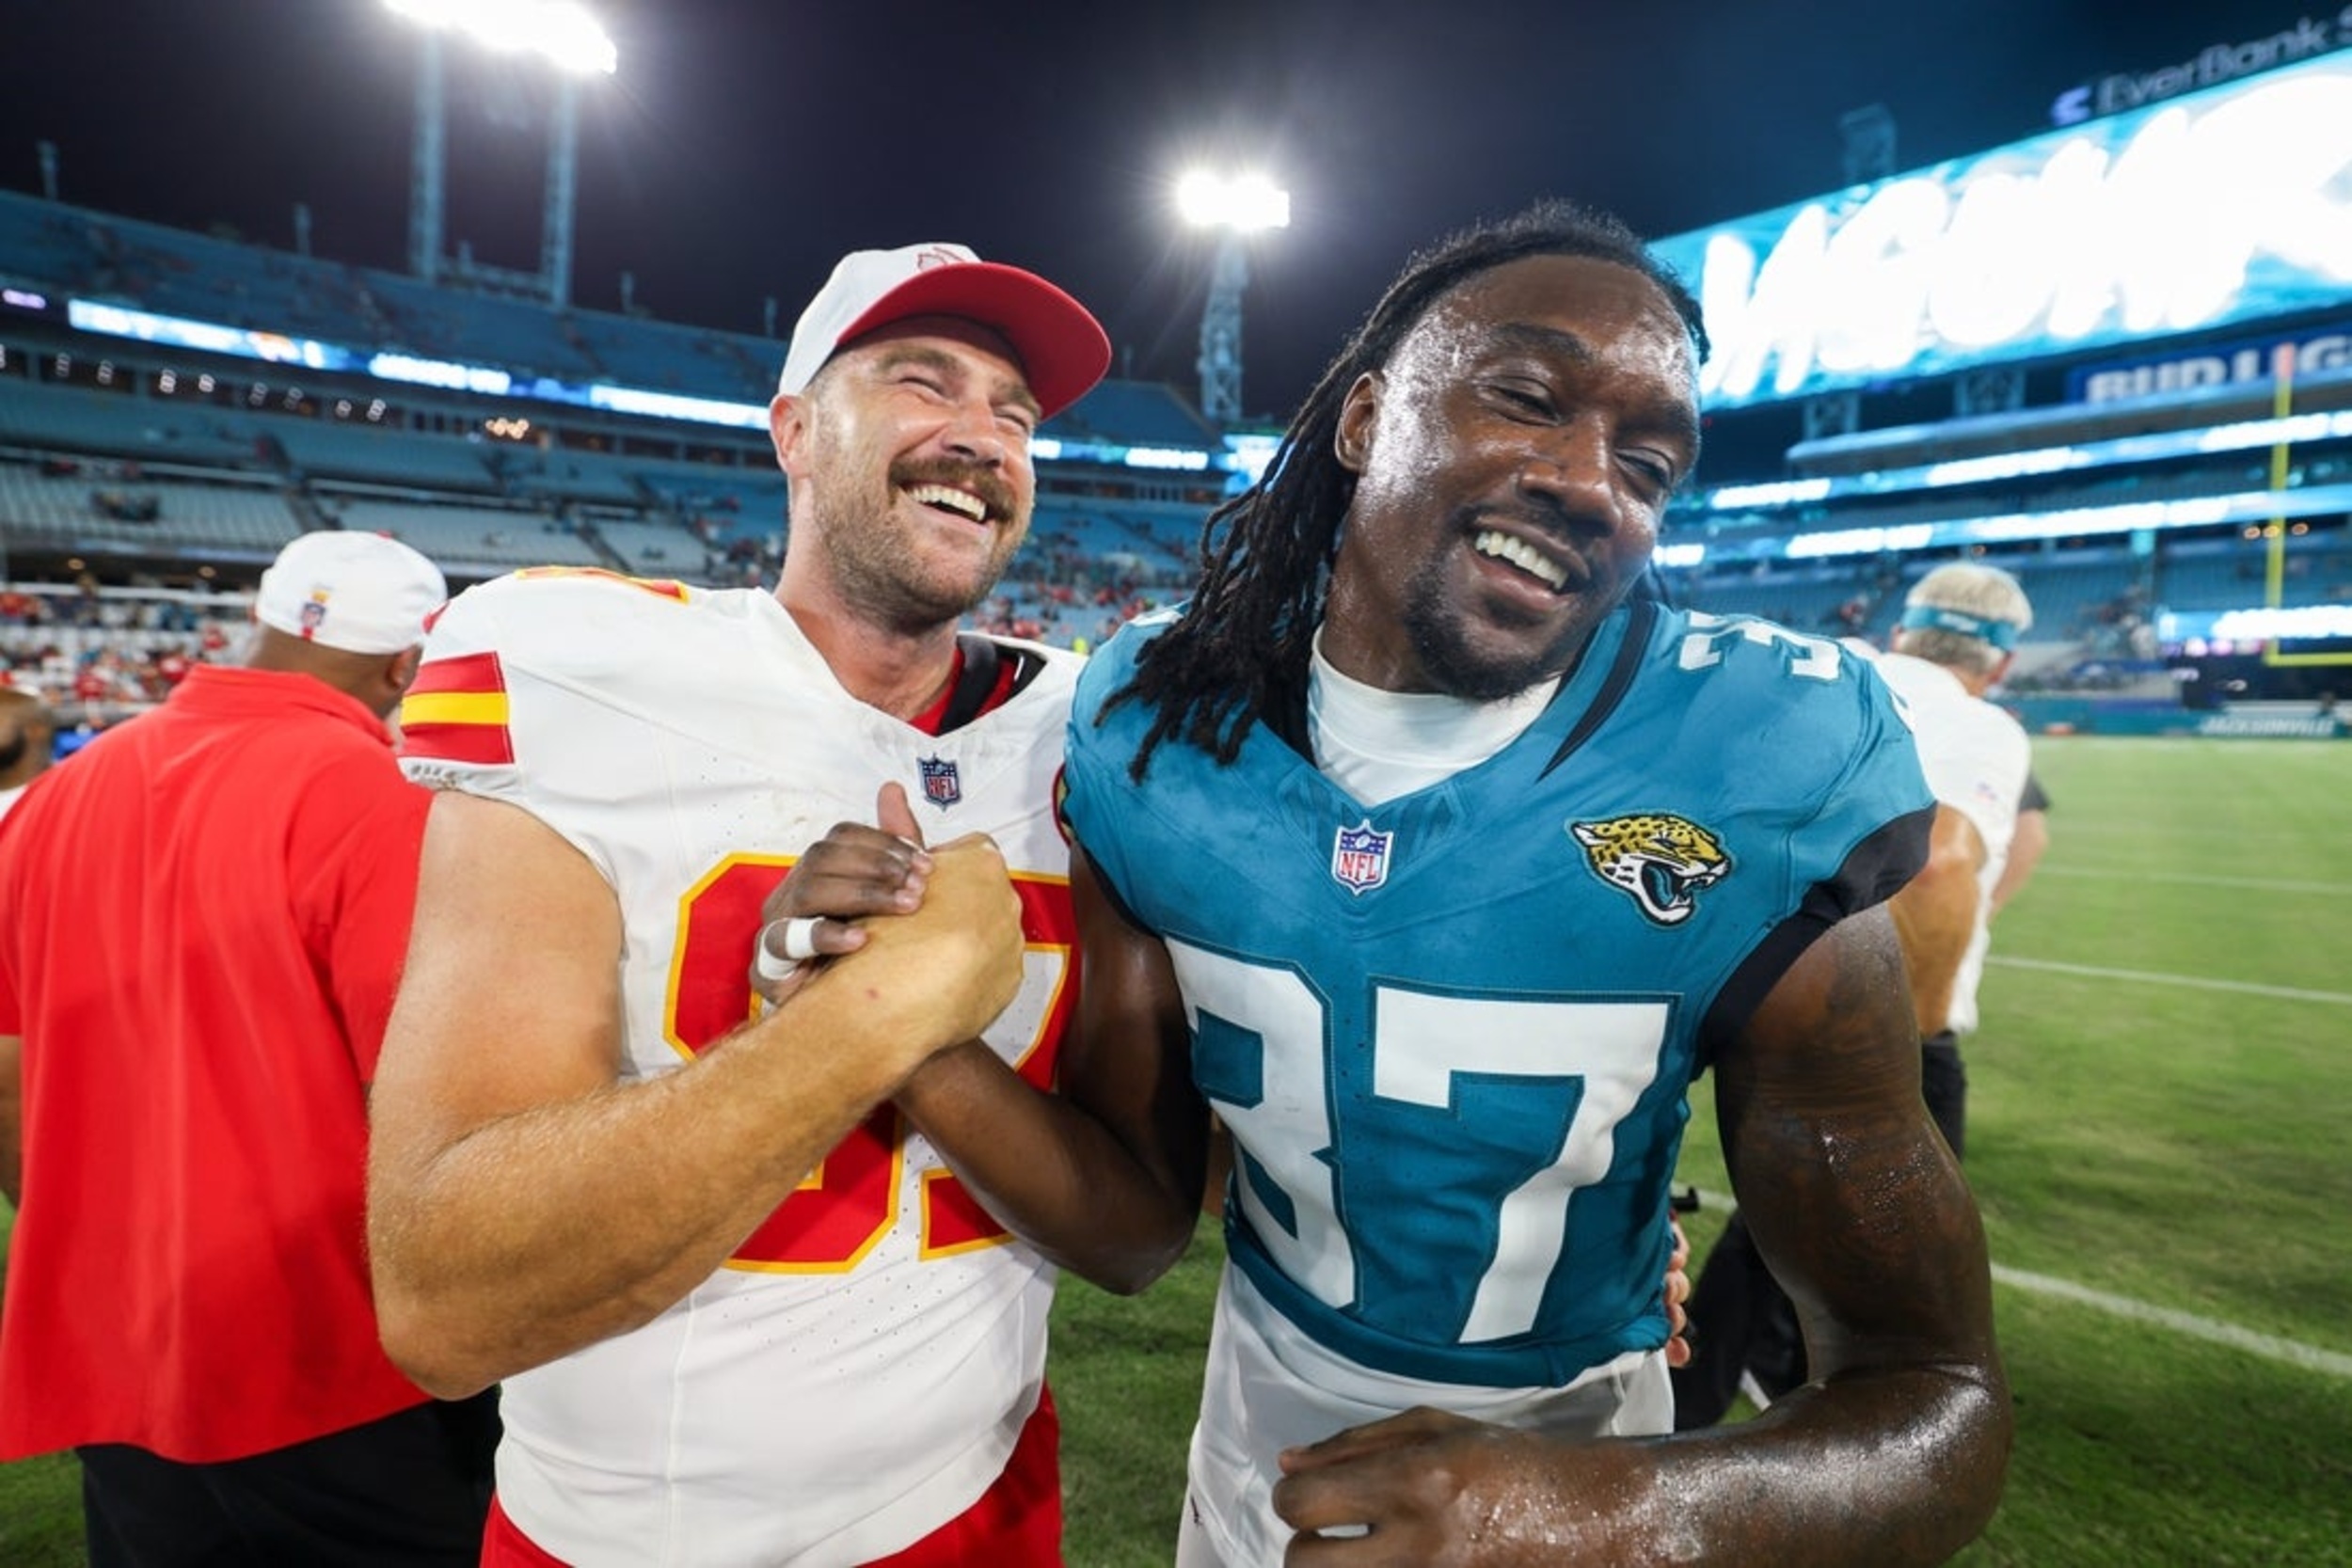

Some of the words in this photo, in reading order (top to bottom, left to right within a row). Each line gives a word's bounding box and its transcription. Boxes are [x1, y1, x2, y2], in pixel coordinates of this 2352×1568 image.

[2096, 17, 2329, 115] EverBank
[928, 776, 957, 799] NFL
[1340, 851, 1378, 882] NFL
